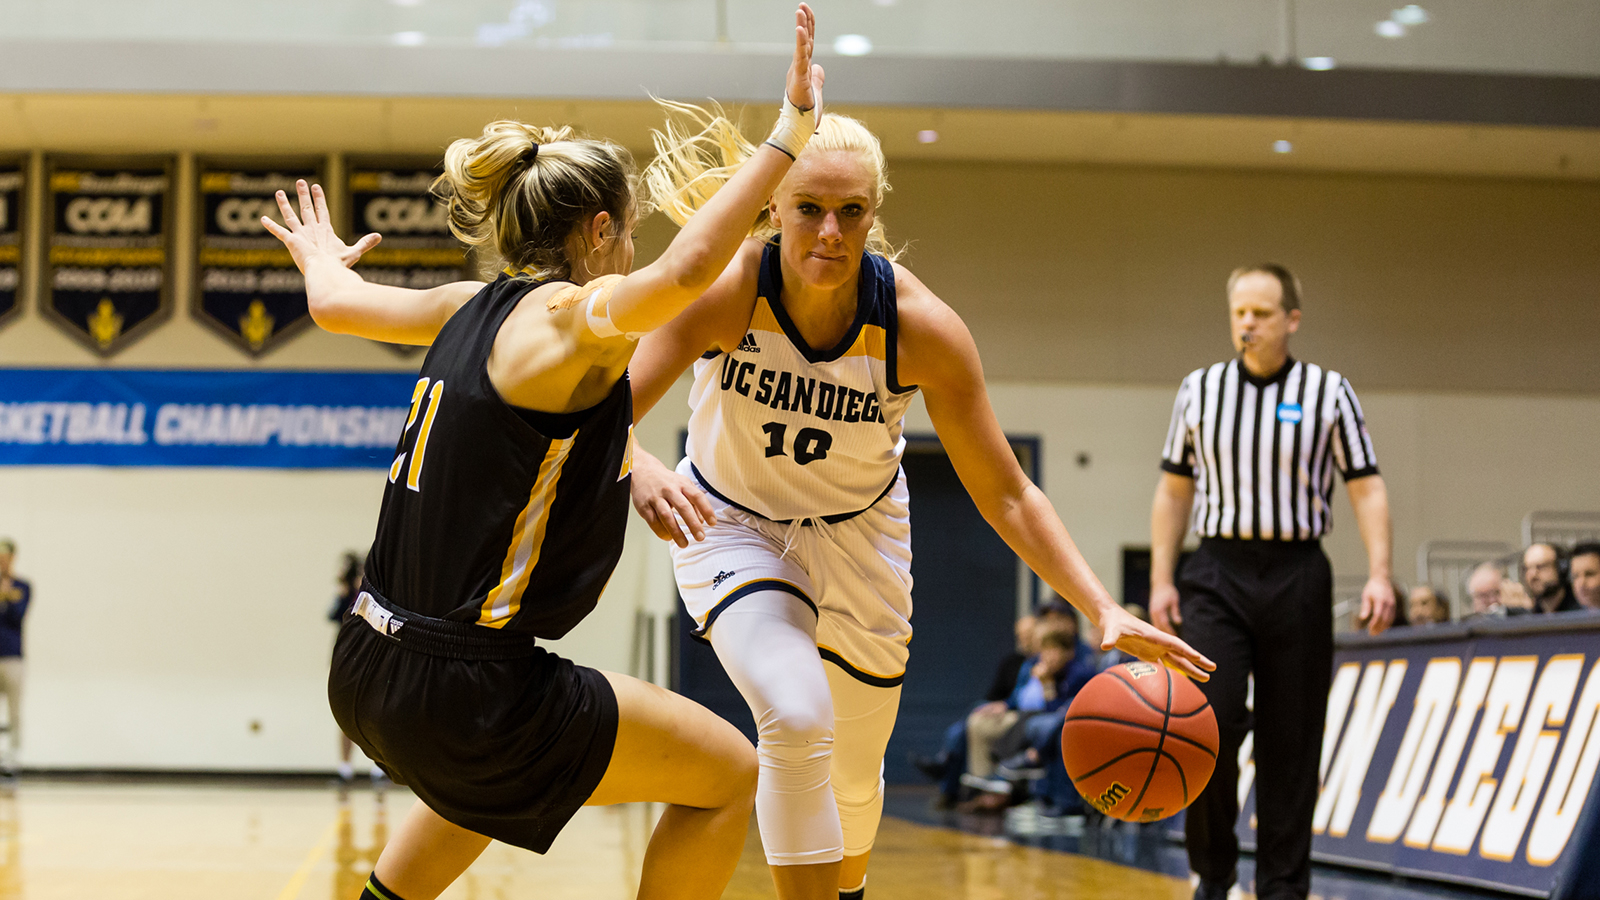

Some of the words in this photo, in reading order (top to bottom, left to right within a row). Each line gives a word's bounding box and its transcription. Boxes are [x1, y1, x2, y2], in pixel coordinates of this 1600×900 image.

[721, 354, 756, 397] UC
[755, 368, 816, 415] SAN
[815, 381, 886, 424] DIEG
[762, 421, 832, 466] 10
[1366, 653, 1600, 868] DIEGO
